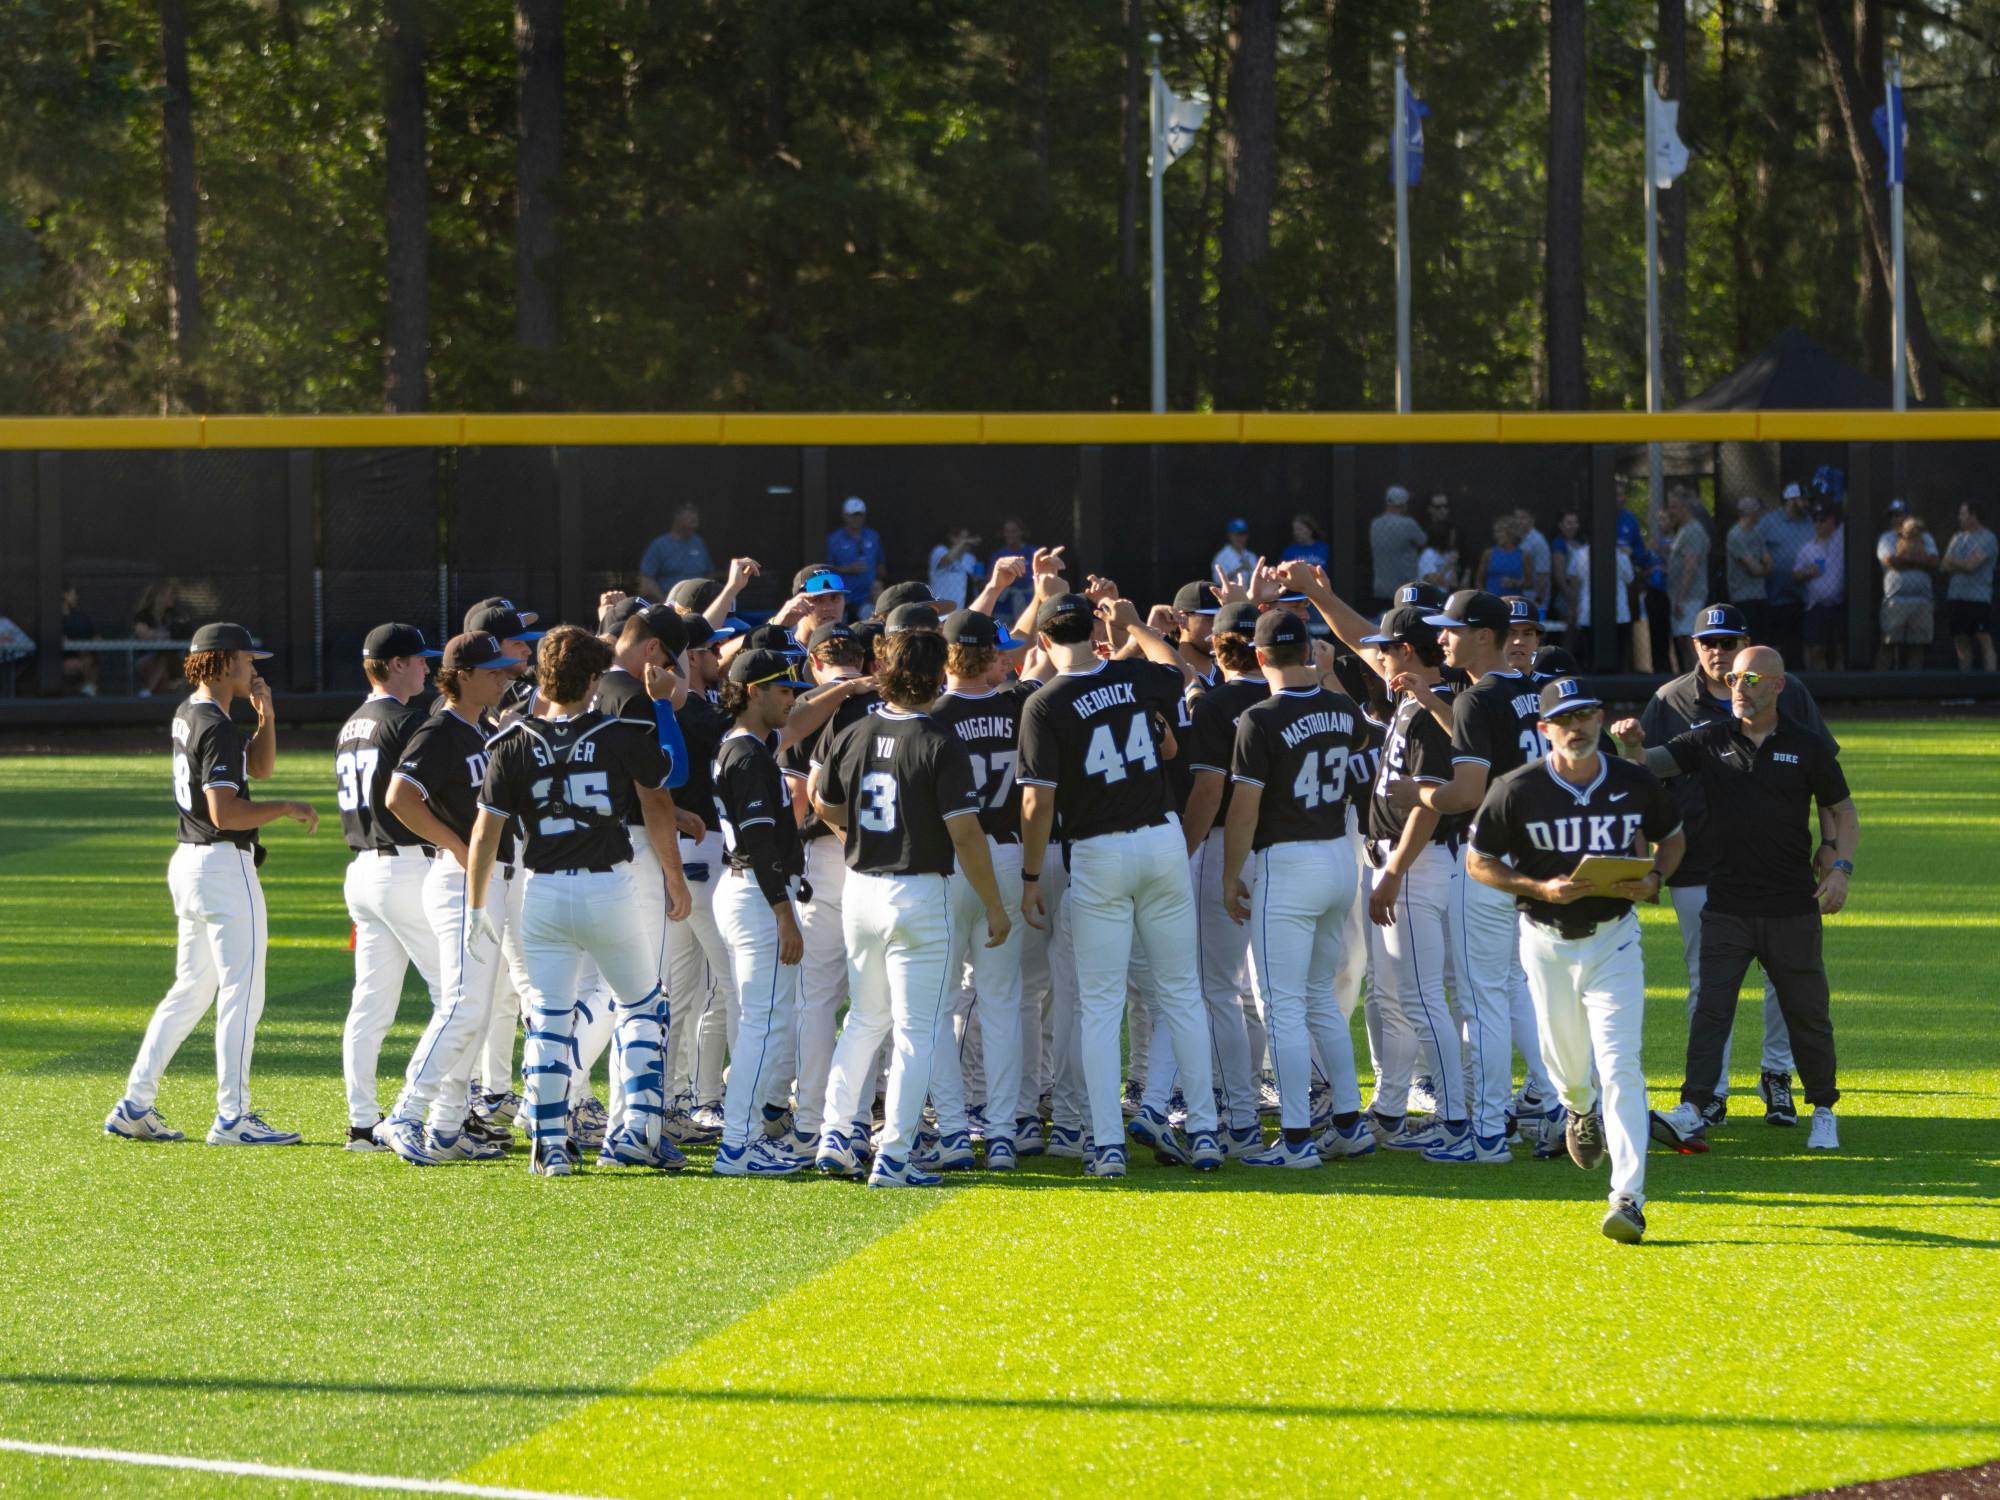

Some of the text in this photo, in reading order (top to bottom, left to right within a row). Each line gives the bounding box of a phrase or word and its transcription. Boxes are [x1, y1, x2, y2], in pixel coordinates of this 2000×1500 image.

[1072, 683, 1136, 720] HEDRICK
[877, 737, 895, 758] YU
[955, 717, 1013, 741] HIGGINS
[1085, 711, 1158, 784] 44
[336, 749, 379, 811] 37
[1294, 746, 1349, 808] 43
[1773, 752, 1798, 764] DUKE
[532, 771, 611, 835] 25
[861, 773, 897, 832] 3
[1526, 814, 1642, 853] DUKE
